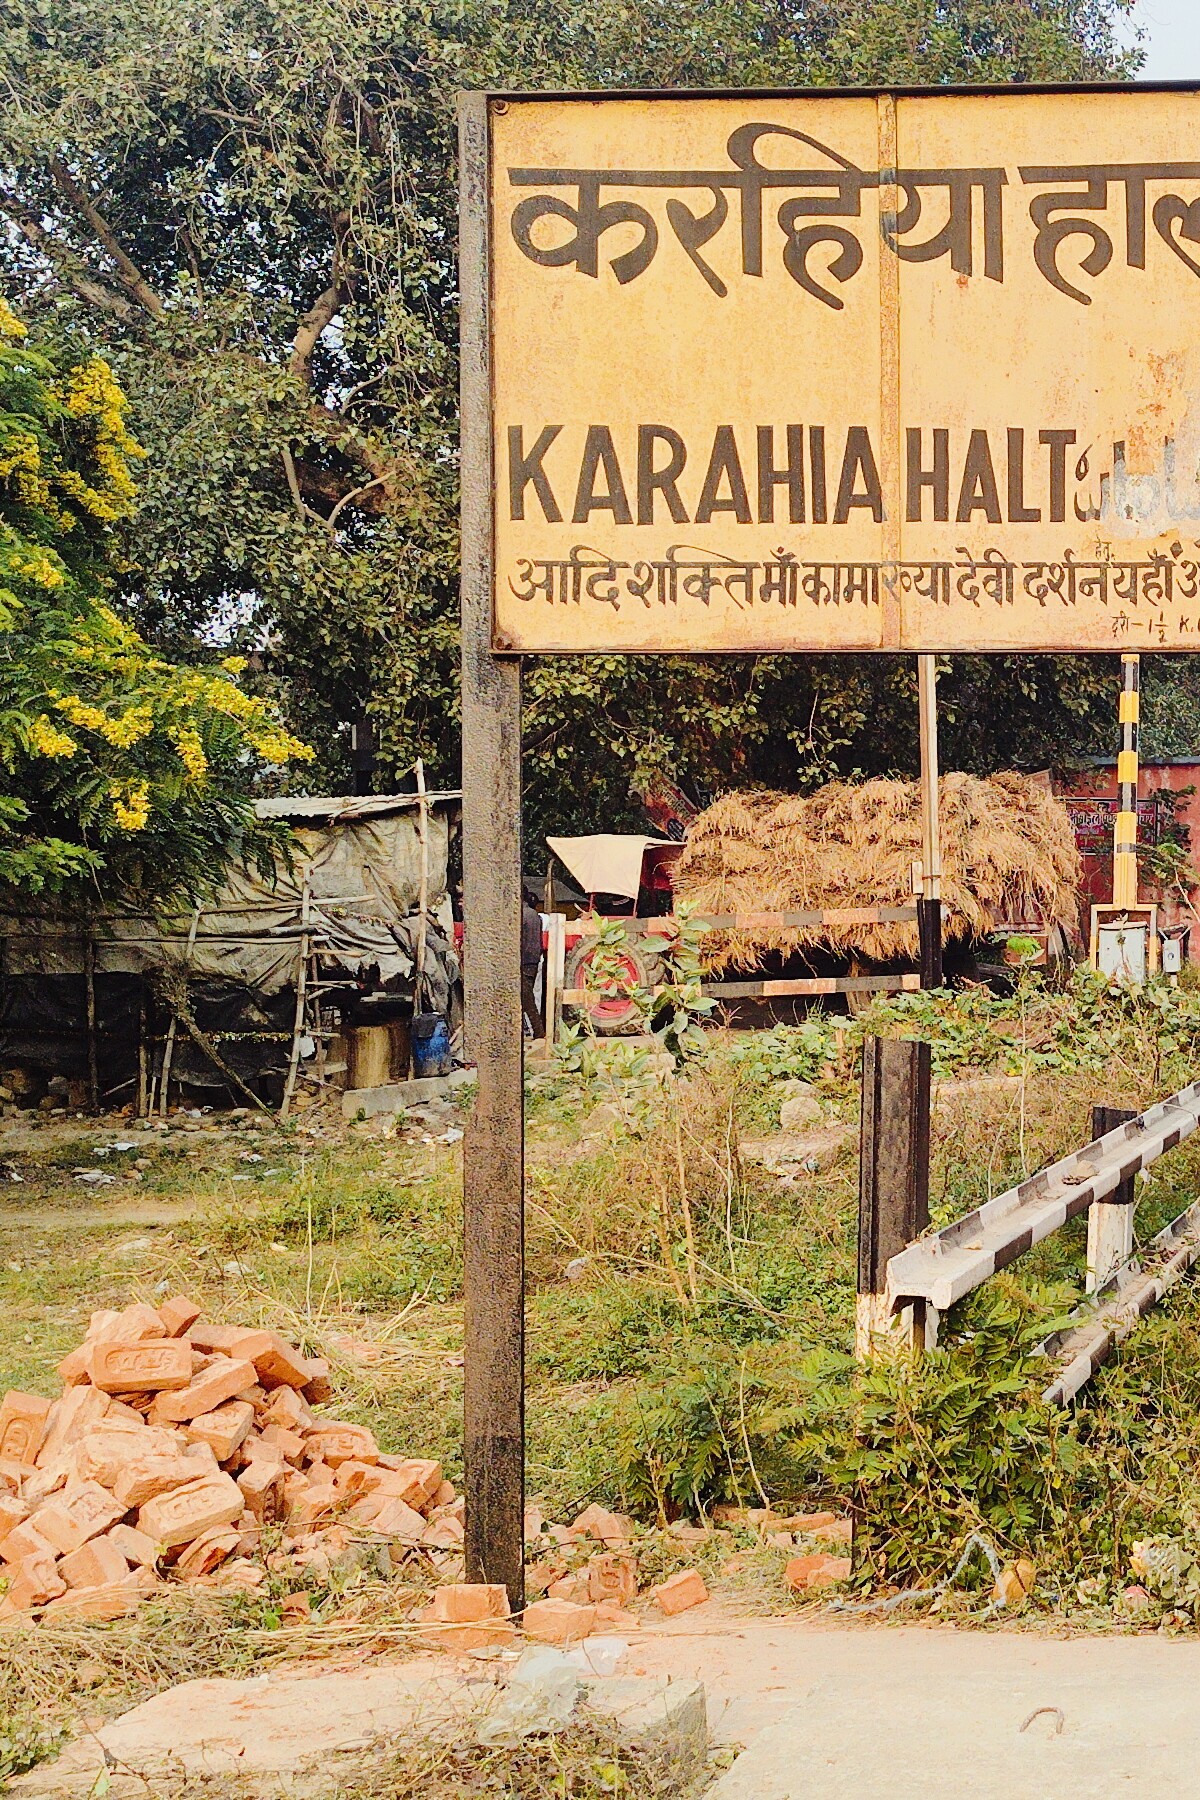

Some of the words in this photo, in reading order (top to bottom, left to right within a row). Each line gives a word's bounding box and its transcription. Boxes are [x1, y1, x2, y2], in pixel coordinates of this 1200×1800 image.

[507, 122, 1009, 311] करहिया
[507, 424, 887, 525] KARAHIA
[905, 427, 1077, 523] HALT
[954, 546, 1019, 608] देवी
[1021, 548, 1112, 608] दर्शन
